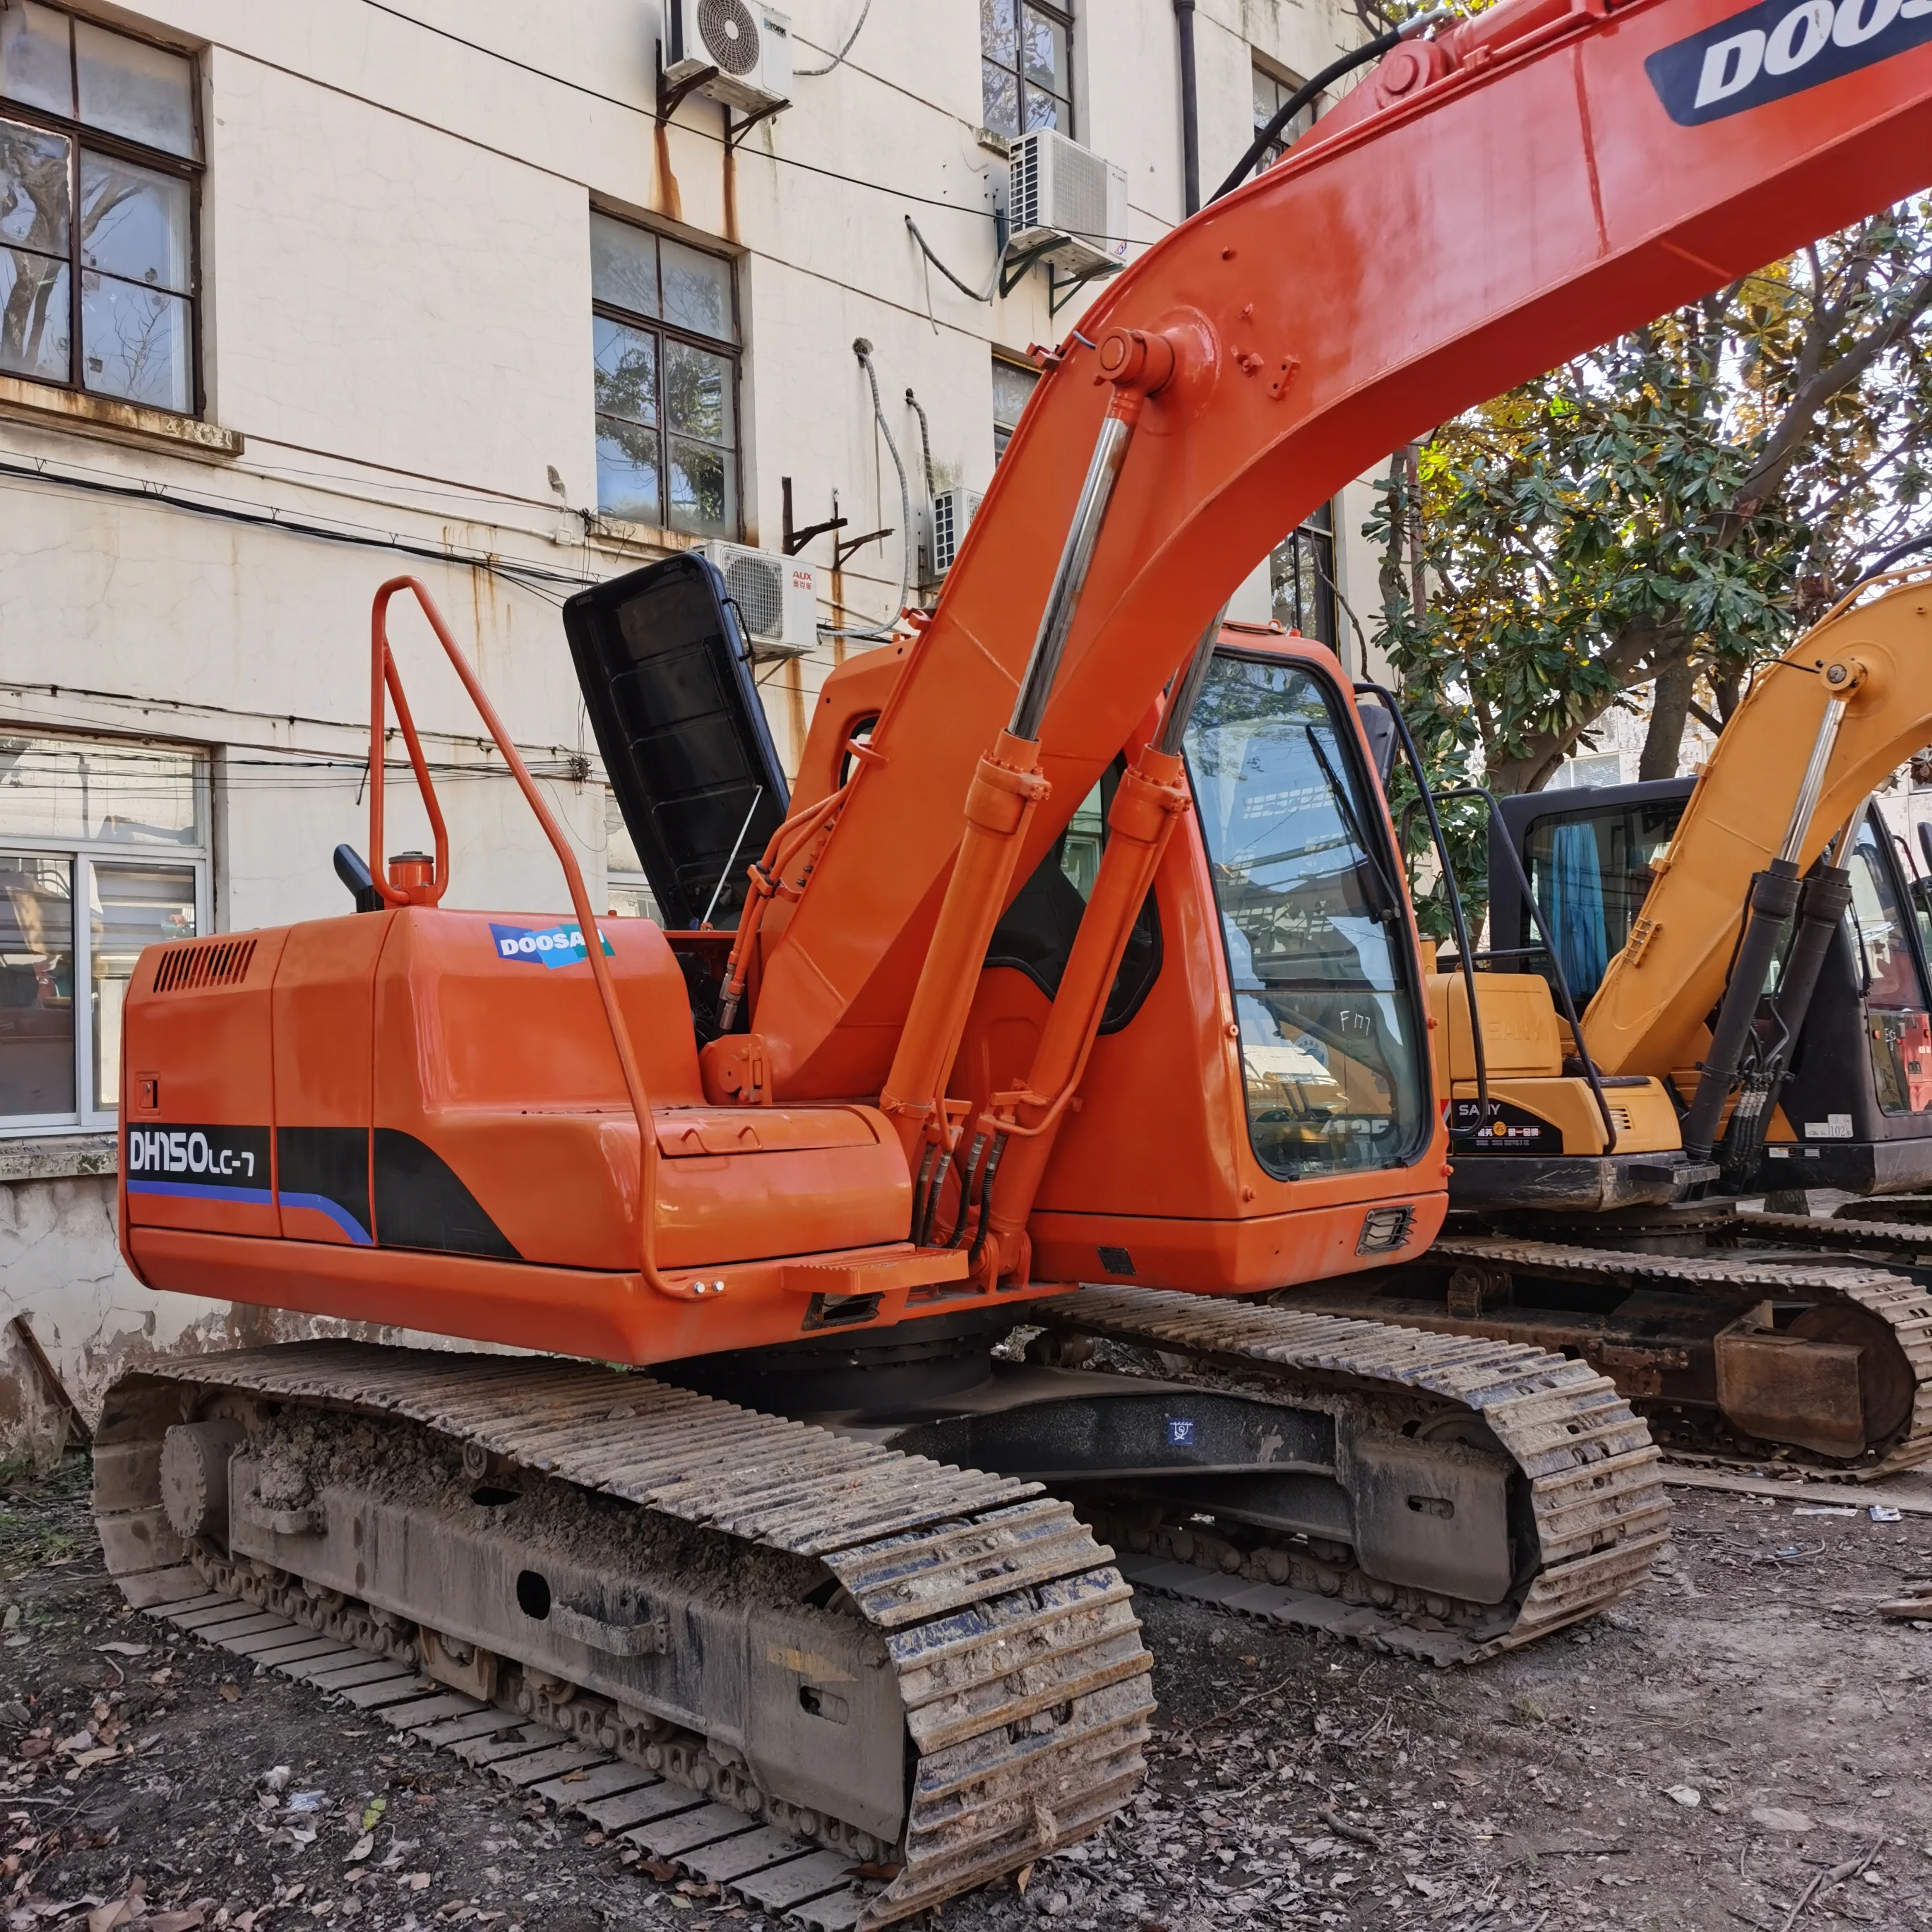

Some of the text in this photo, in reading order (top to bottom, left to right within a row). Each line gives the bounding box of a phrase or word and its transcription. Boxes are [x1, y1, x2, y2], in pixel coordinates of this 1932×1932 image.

[769, 21, 787, 38] YORK
[1693, 0, 1932, 109] DOO
[792, 571, 812, 580] AUX
[793, 580, 812, 590] 奥克斯
